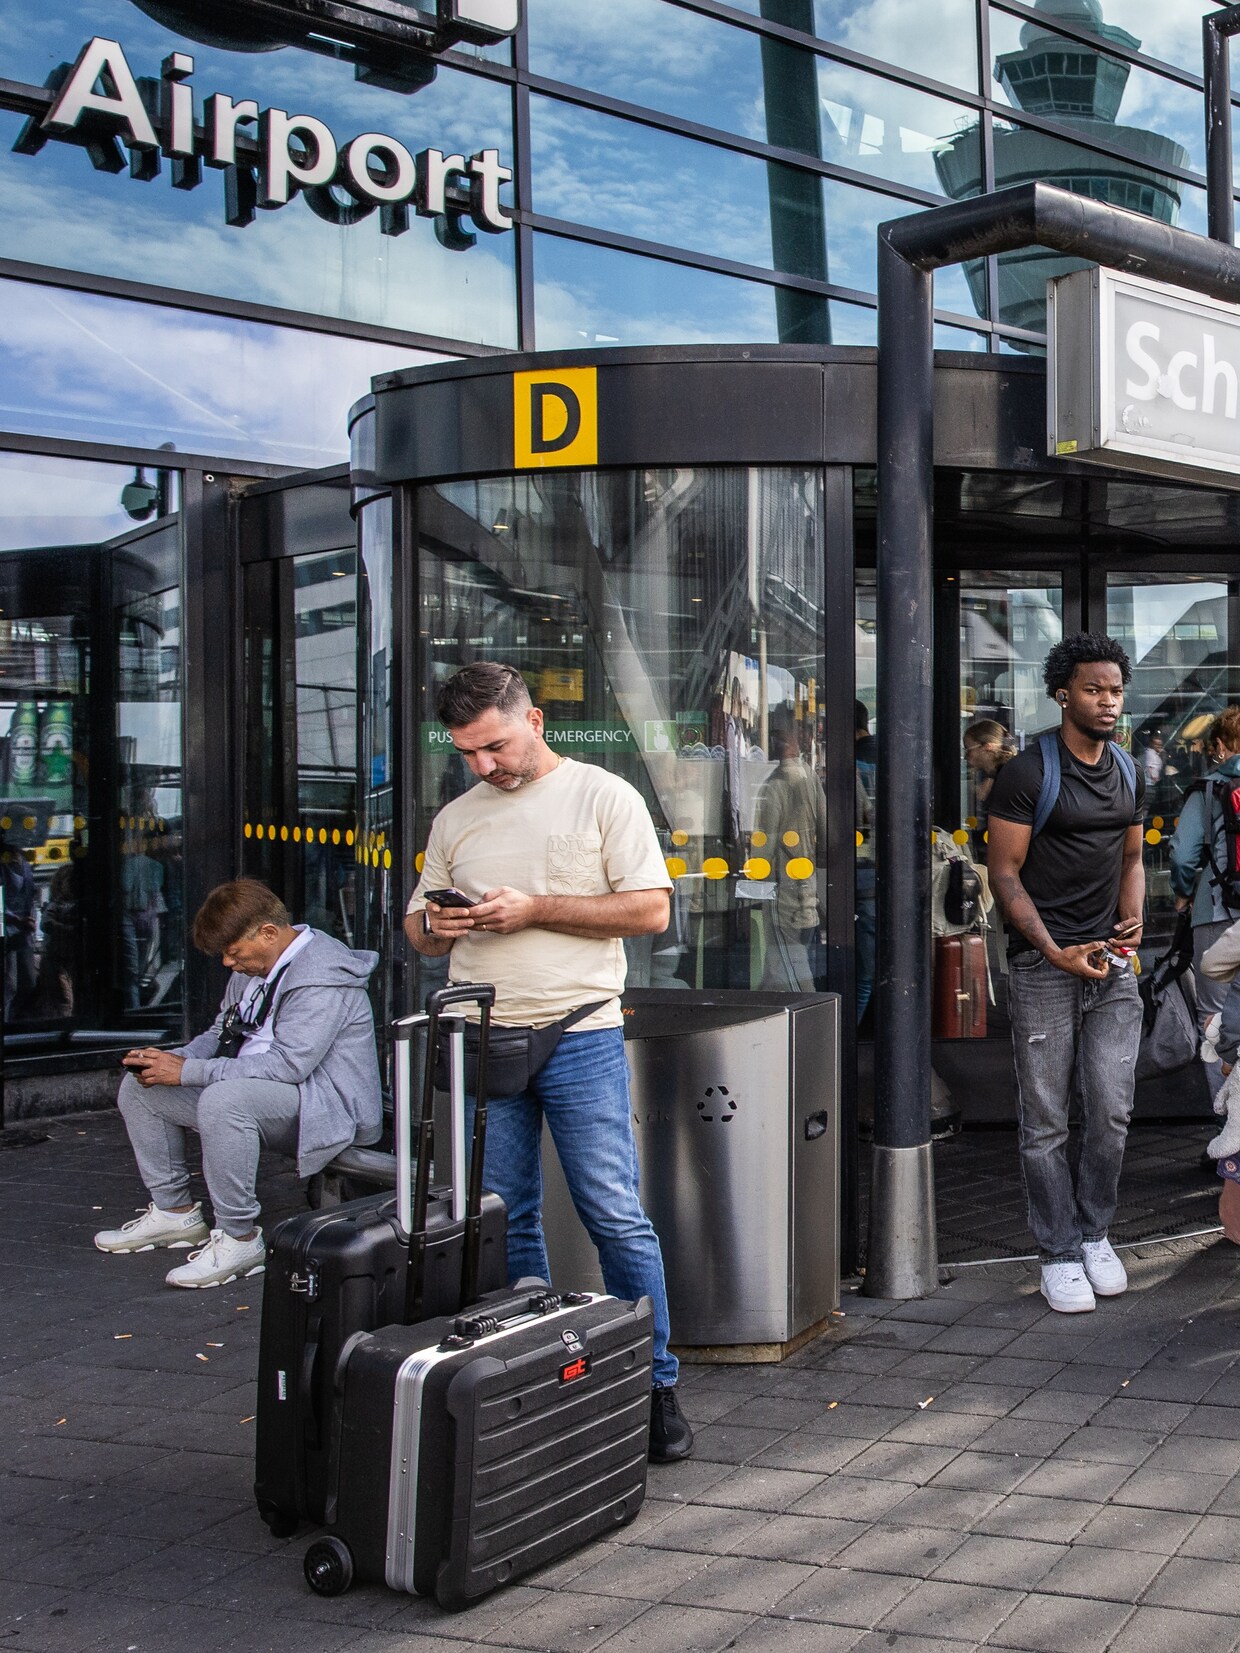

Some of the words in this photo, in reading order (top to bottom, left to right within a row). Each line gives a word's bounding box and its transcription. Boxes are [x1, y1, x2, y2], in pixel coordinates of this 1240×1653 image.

[41, 36, 513, 234] Airport
[530, 382, 581, 454] D
[428, 731, 455, 744] PUS
[546, 729, 632, 743] EMERGENCY
